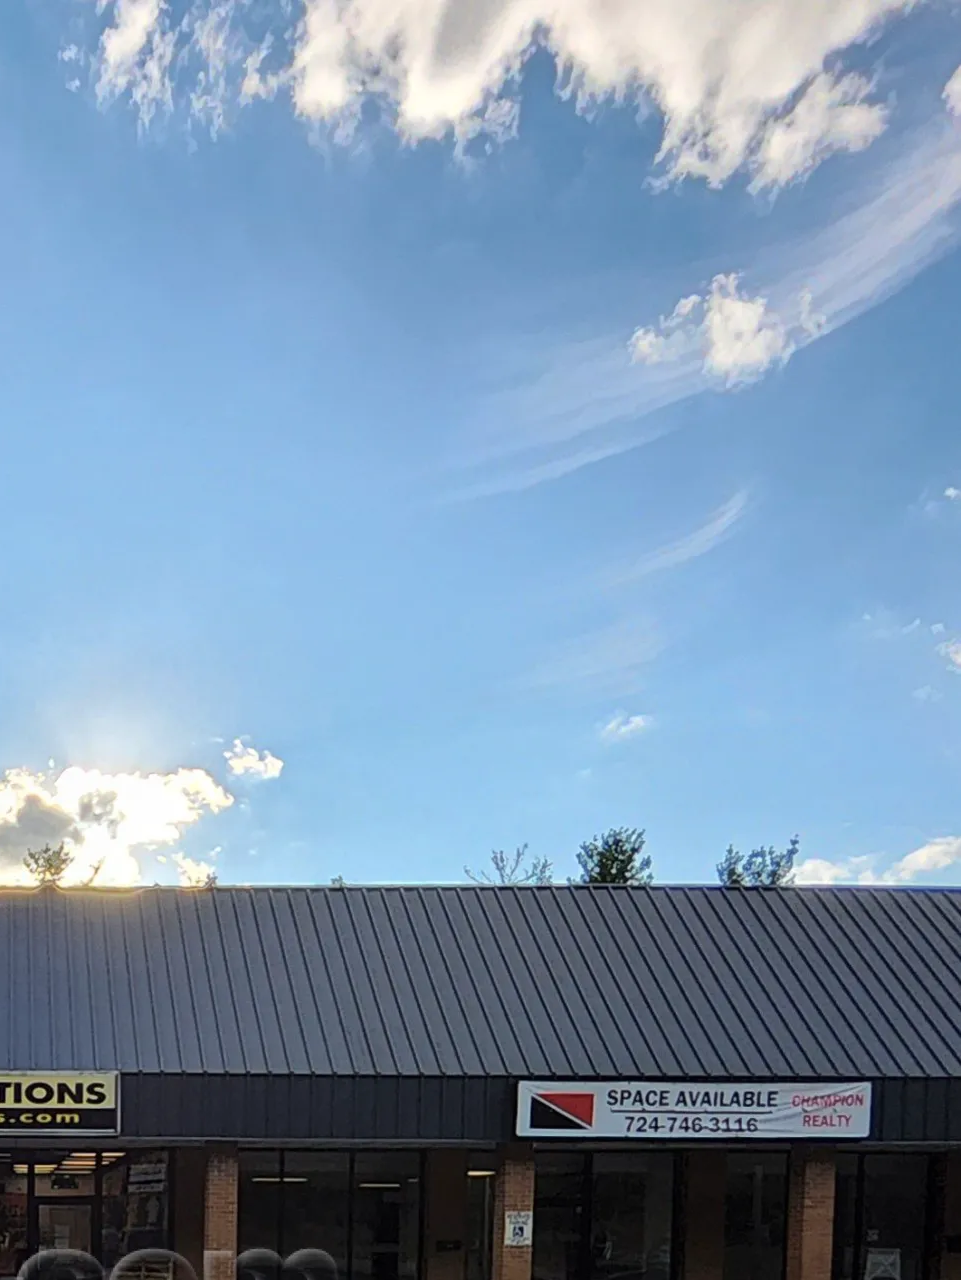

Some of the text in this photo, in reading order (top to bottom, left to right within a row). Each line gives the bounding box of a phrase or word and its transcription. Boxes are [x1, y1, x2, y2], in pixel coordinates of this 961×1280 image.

[606, 1089, 778, 1109] SPACE AVAILABLE
[791, 1093, 865, 1108] CHAMPION
[625, 1116, 759, 1133] 724-746-3116
[802, 1114, 852, 1127] REALTY
